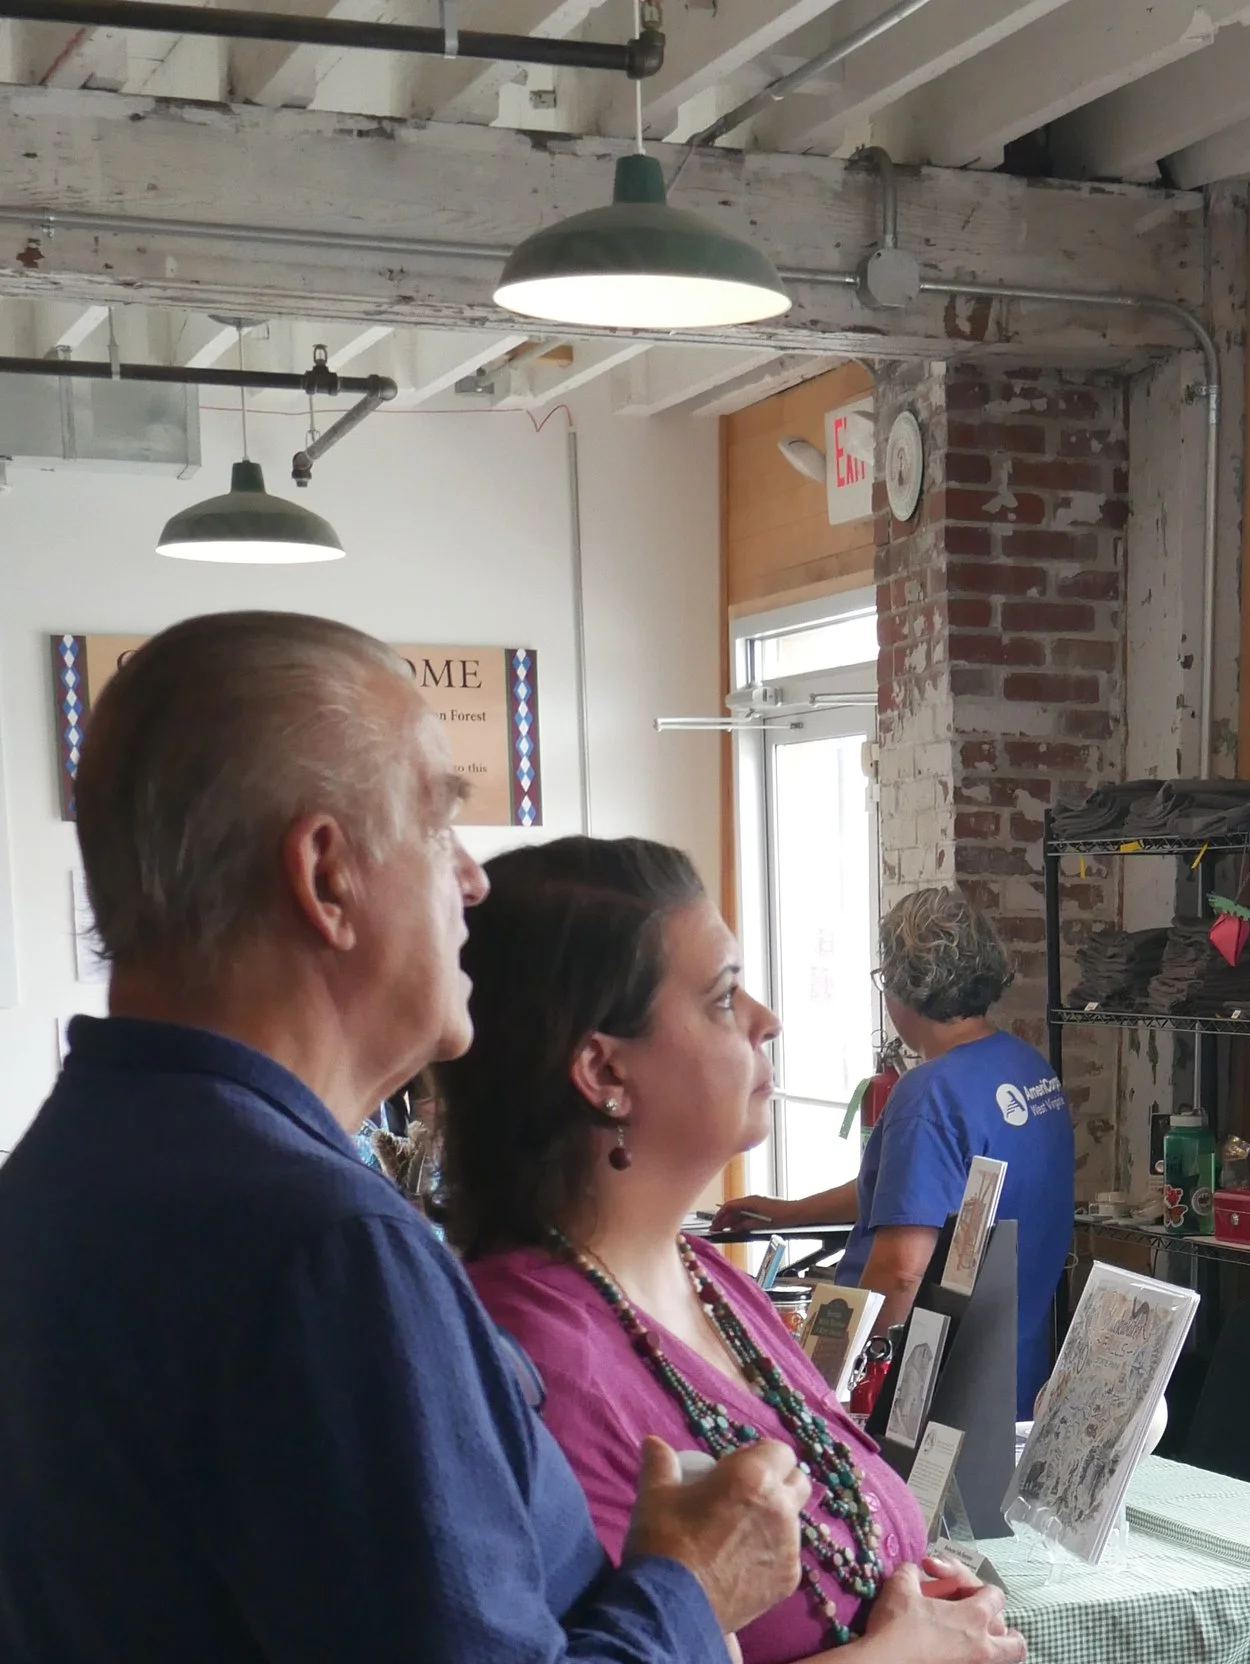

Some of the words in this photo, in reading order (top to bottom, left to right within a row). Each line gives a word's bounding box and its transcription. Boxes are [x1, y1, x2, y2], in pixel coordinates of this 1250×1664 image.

[450, 709, 486, 722] Forest
[468, 762, 487, 773] this
[1023, 1076, 1062, 1101] AmeriCorp
[1030, 1099, 1048, 1117] West
